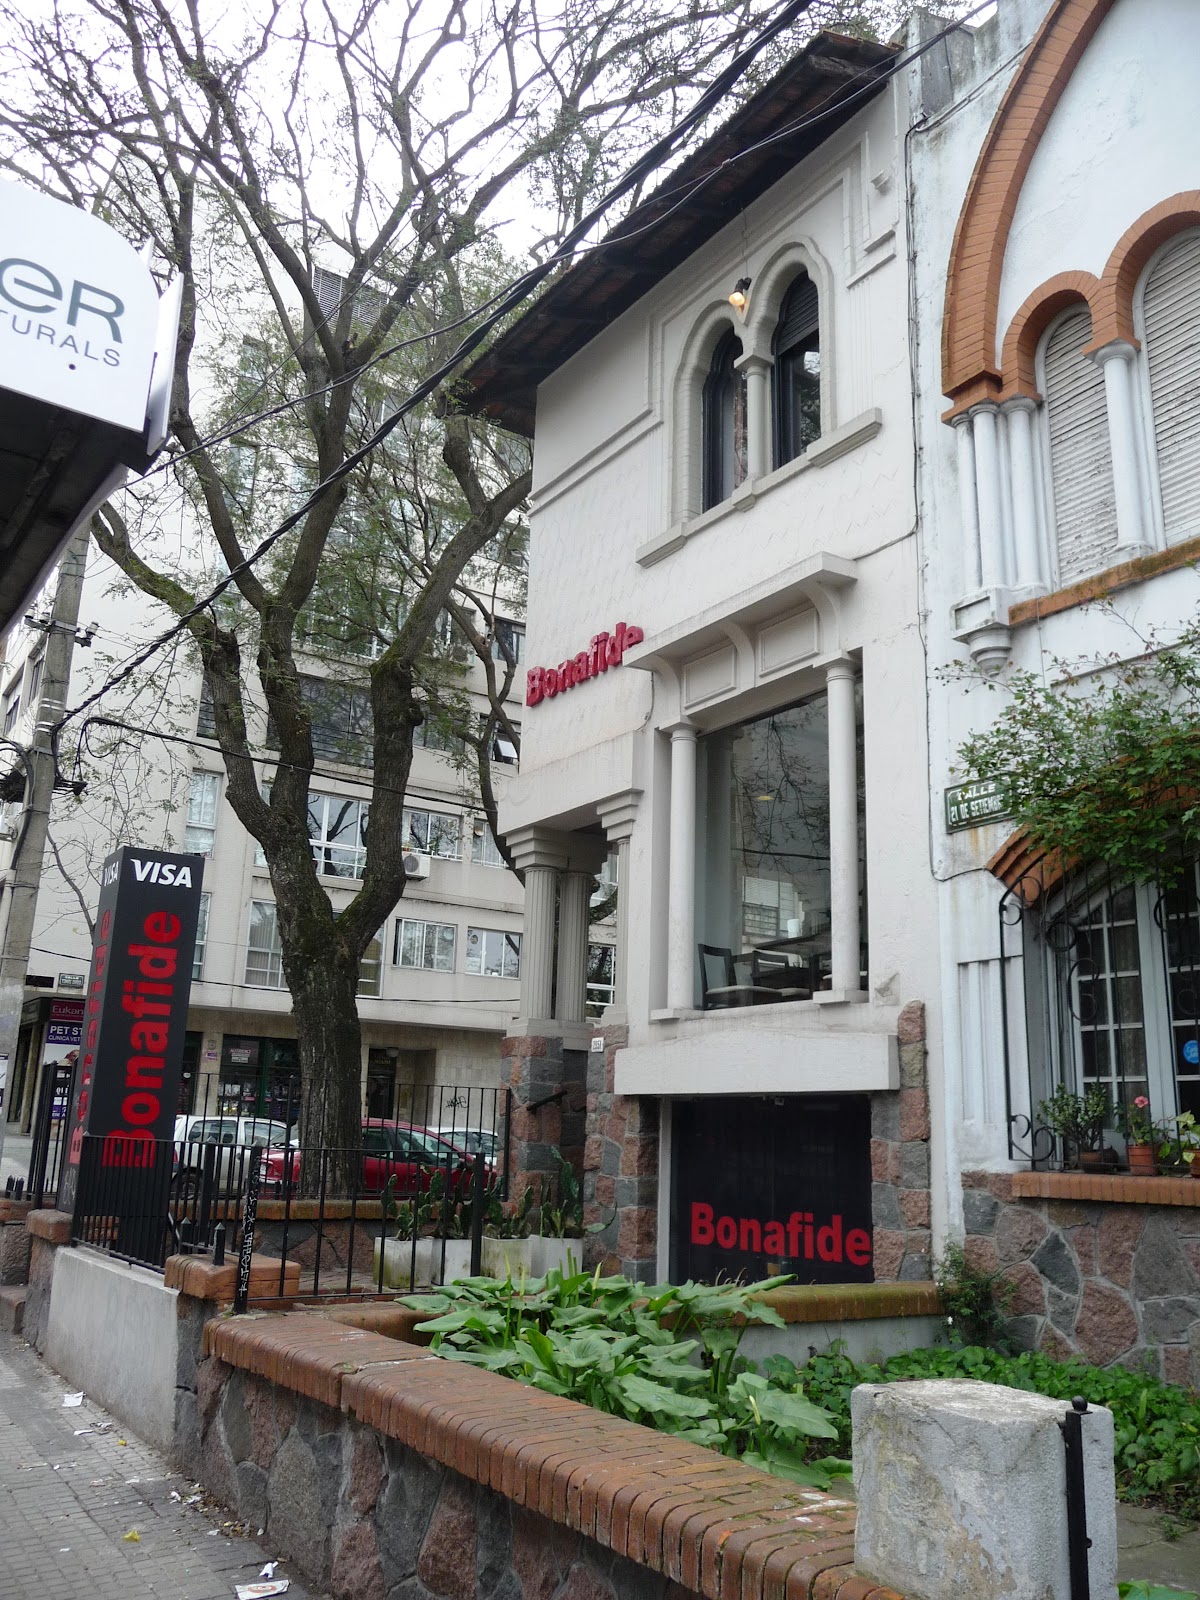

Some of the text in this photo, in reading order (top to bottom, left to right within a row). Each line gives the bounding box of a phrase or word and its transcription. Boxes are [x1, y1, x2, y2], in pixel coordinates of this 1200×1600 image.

[526, 621, 644, 707] Bonafide
[951, 806, 959, 822] 21
[961, 803, 970, 819] DE
[104, 860, 119, 887] VISA
[130, 858, 193, 888] VISA
[50, 1025, 70, 1035] PET
[102, 910, 182, 1169] Bonafide
[691, 1201, 872, 1266] Bonafide
